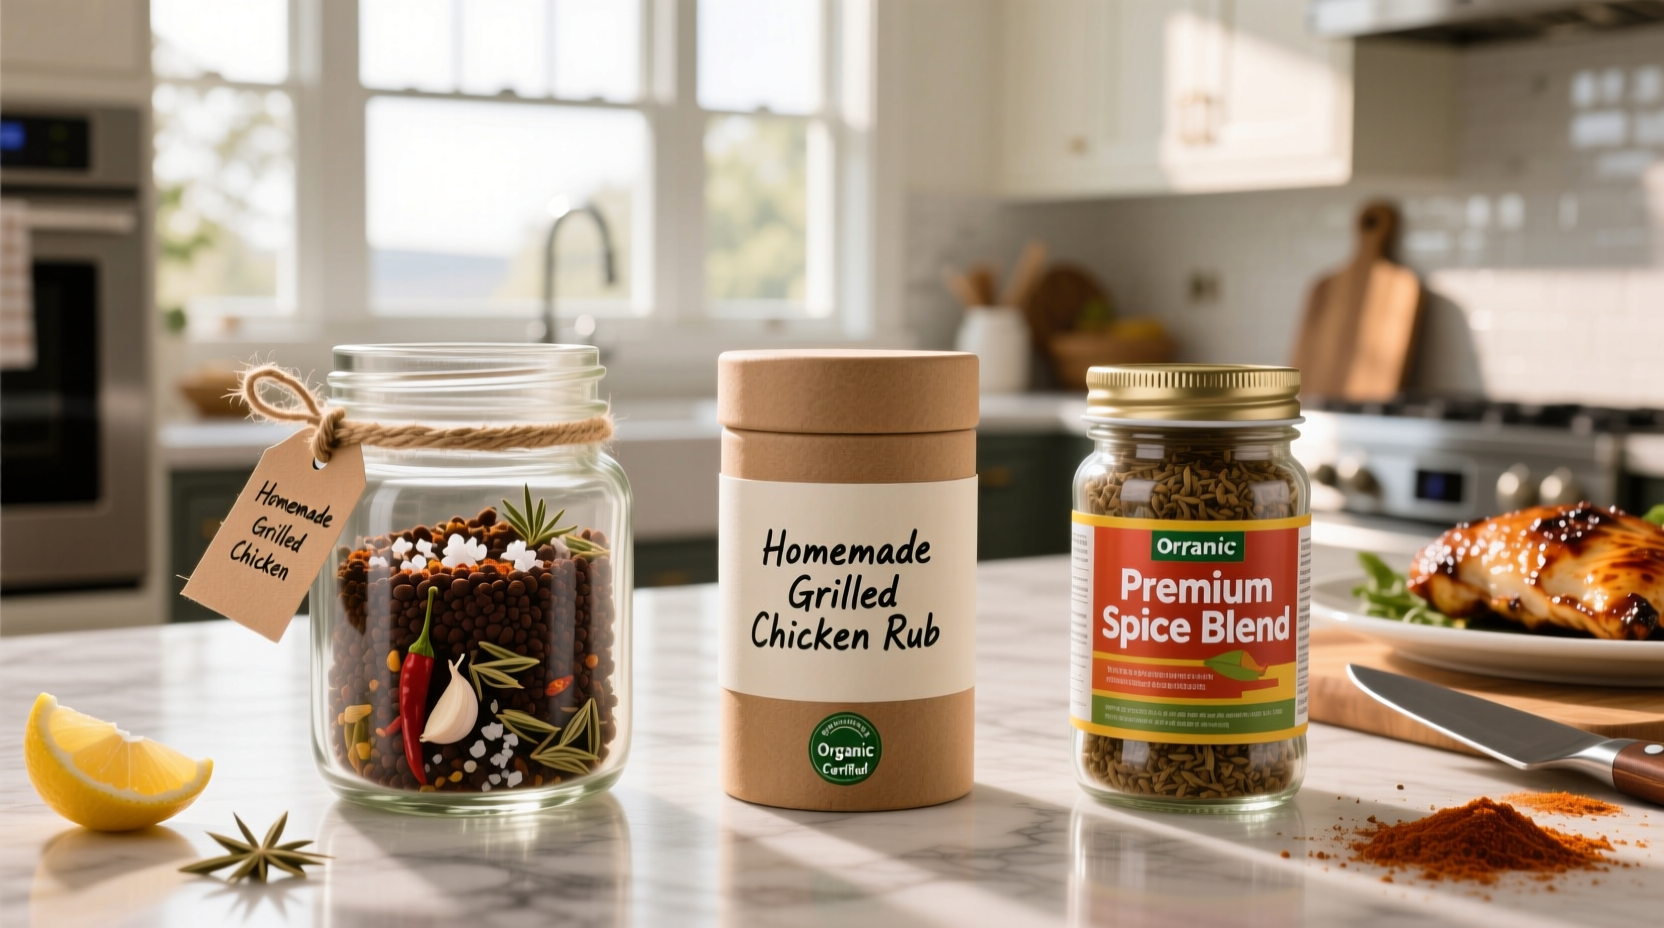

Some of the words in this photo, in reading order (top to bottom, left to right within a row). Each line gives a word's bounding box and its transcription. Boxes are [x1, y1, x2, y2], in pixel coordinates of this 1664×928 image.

[254, 480, 333, 528] Homemade
[252, 516, 308, 553] Grilled
[762, 528, 931, 567] Homemade
[1157, 536, 1236, 556] Orranic
[230, 540, 289, 581] Chicken
[788, 573, 899, 612] Grilled
[1121, 567, 1273, 605] Premium
[751, 611, 869, 651] Chicken
[883, 611, 940, 651] Rub
[1102, 604, 1191, 649] Spice
[1201, 605, 1290, 643] Blend
[817, 742, 875, 761] Organic
